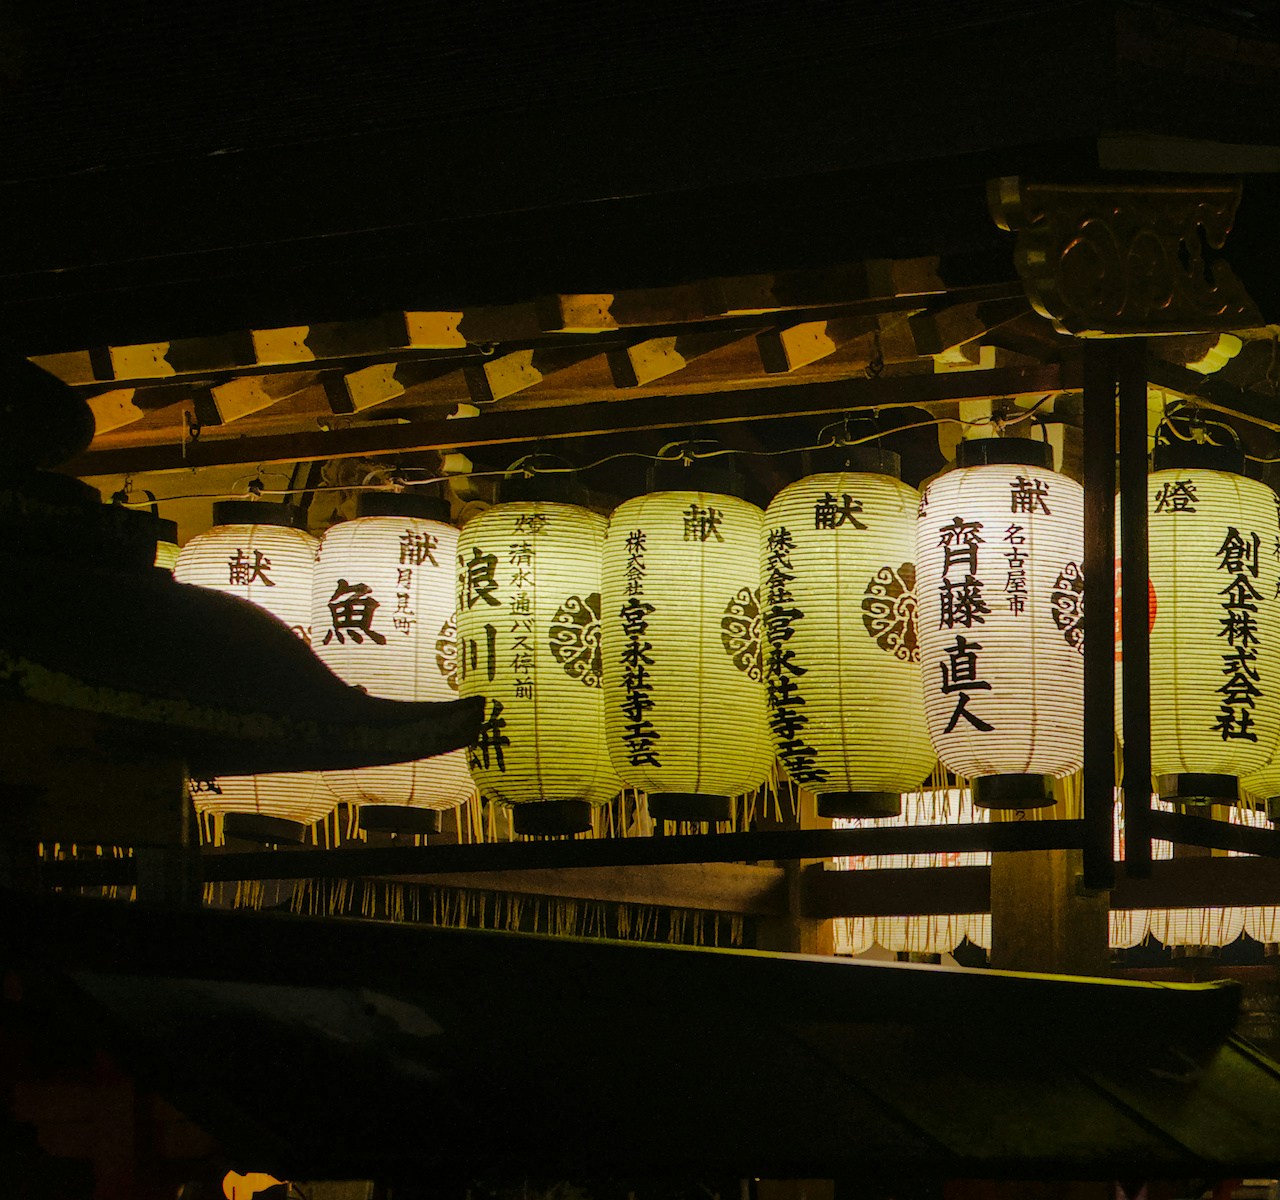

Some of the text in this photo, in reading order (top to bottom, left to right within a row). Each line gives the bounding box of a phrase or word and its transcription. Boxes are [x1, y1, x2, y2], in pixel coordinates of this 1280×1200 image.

[815, 492, 868, 530] 献
[1010, 476, 1050, 515] 献
[1154, 479, 1200, 513] 燈
[683, 504, 724, 542] 献
[399, 529, 439, 567] 献
[229, 549, 276, 587] 献
[1003, 523, 1029, 616] 名古屋市
[322, 579, 387, 646] 魚
[509, 540, 536, 700] 清水通バス停前
[1210, 527, 1265, 742] 創企株式会社
